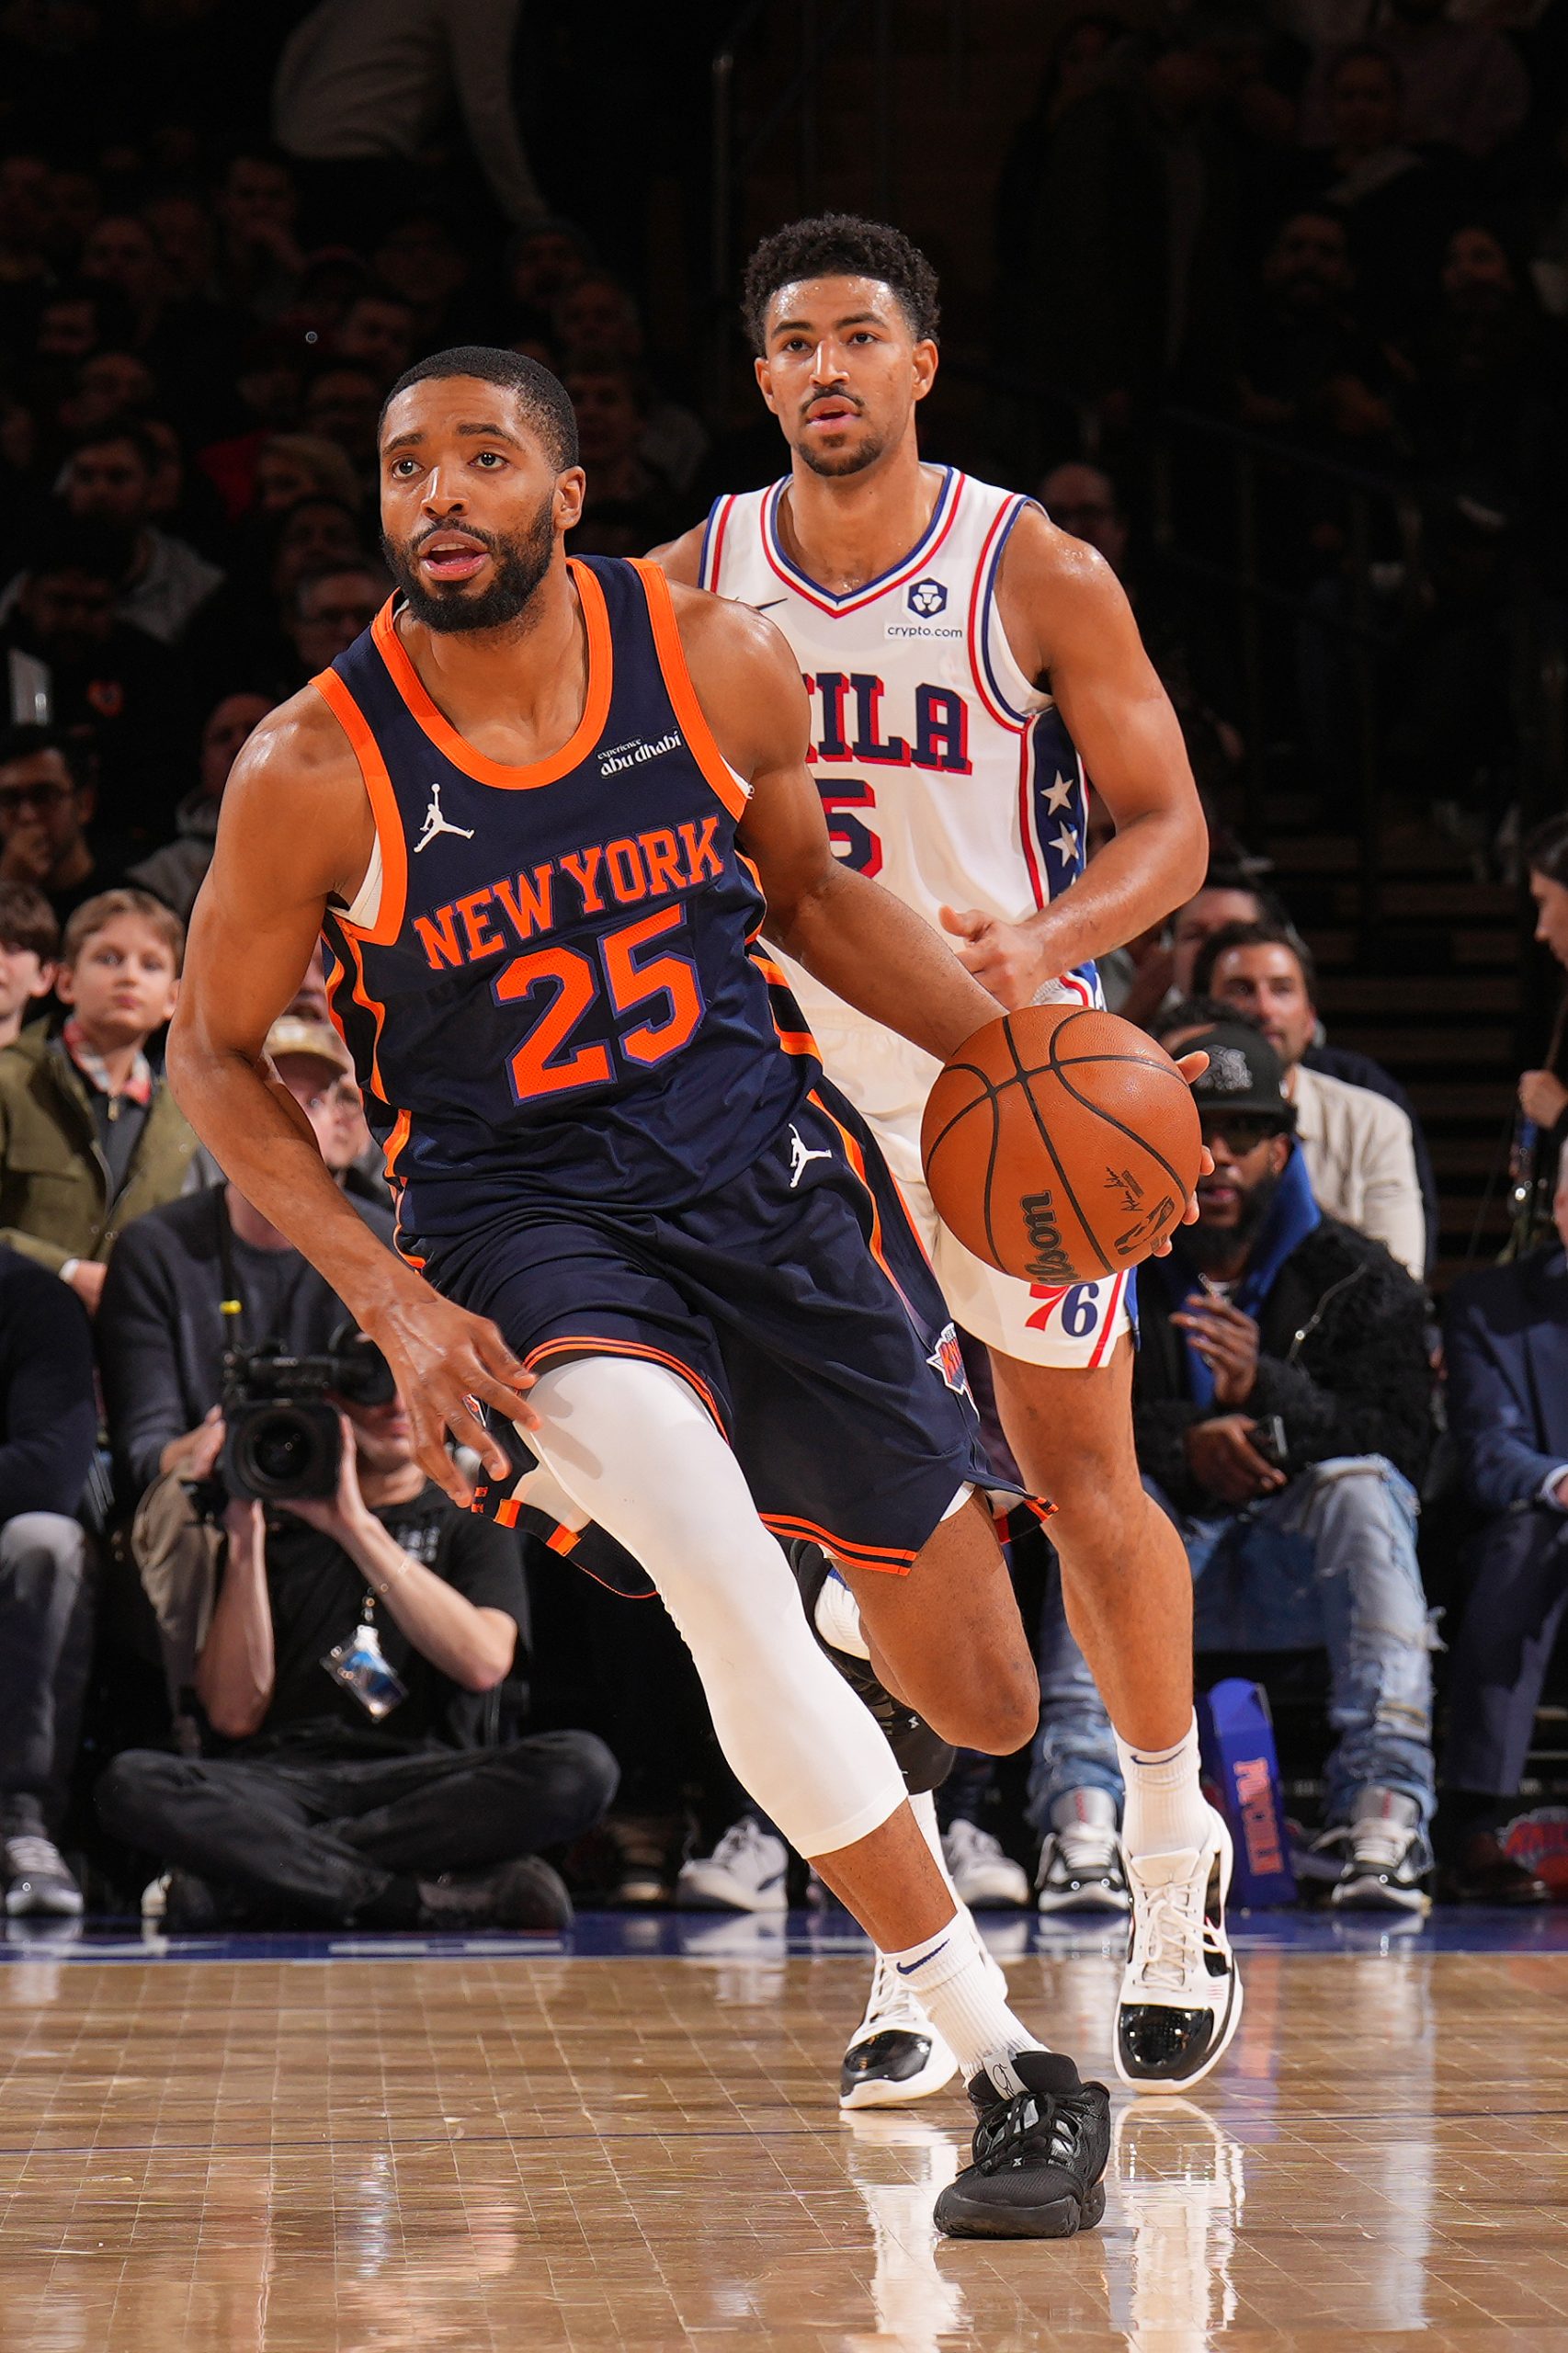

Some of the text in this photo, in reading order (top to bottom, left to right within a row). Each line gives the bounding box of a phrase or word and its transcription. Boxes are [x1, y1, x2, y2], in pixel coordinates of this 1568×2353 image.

[887, 625, 963, 639] crypto.com
[597, 738, 642, 760] experience
[600, 730, 682, 776] abu dhabi
[802, 672, 973, 776] ILA
[412, 814, 725, 971] NEW YORK
[490, 902, 706, 1108] 25
[1020, 1190, 1082, 1285] ilson
[1025, 1282, 1099, 1337] 76
